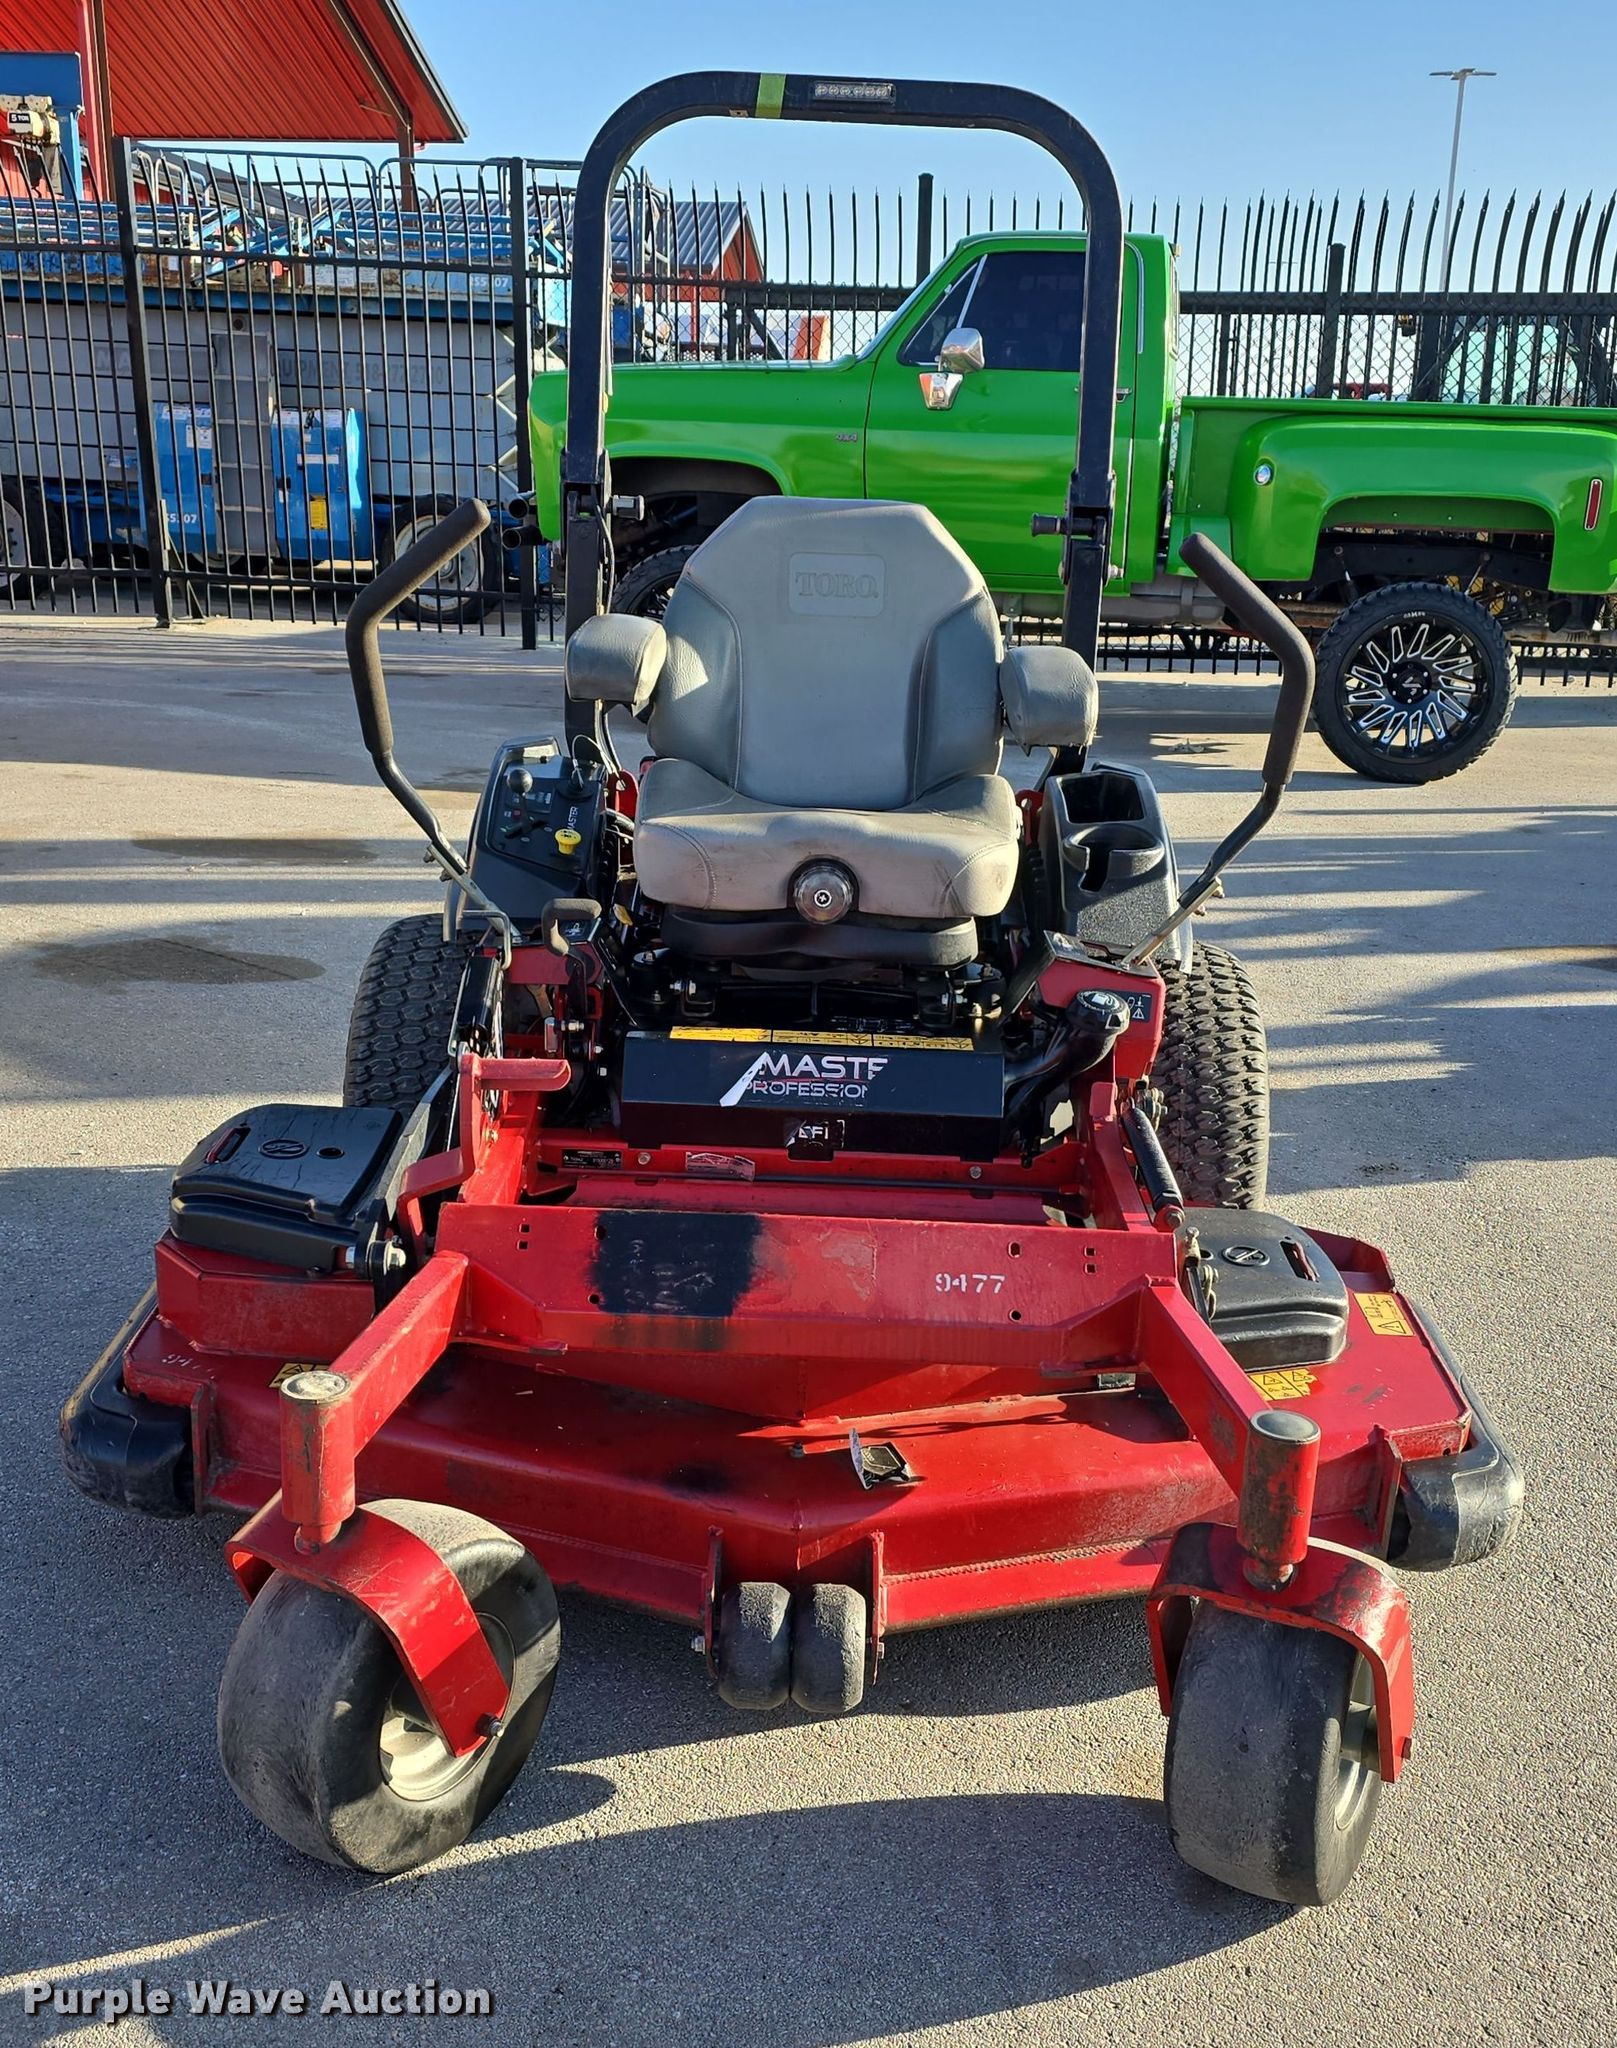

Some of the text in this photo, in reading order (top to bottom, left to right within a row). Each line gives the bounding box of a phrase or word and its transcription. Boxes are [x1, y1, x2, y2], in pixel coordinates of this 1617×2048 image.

[795, 572, 878, 599] TORO
[566, 806, 579, 830] ASTER
[935, 1273, 1005, 1294] 9477
